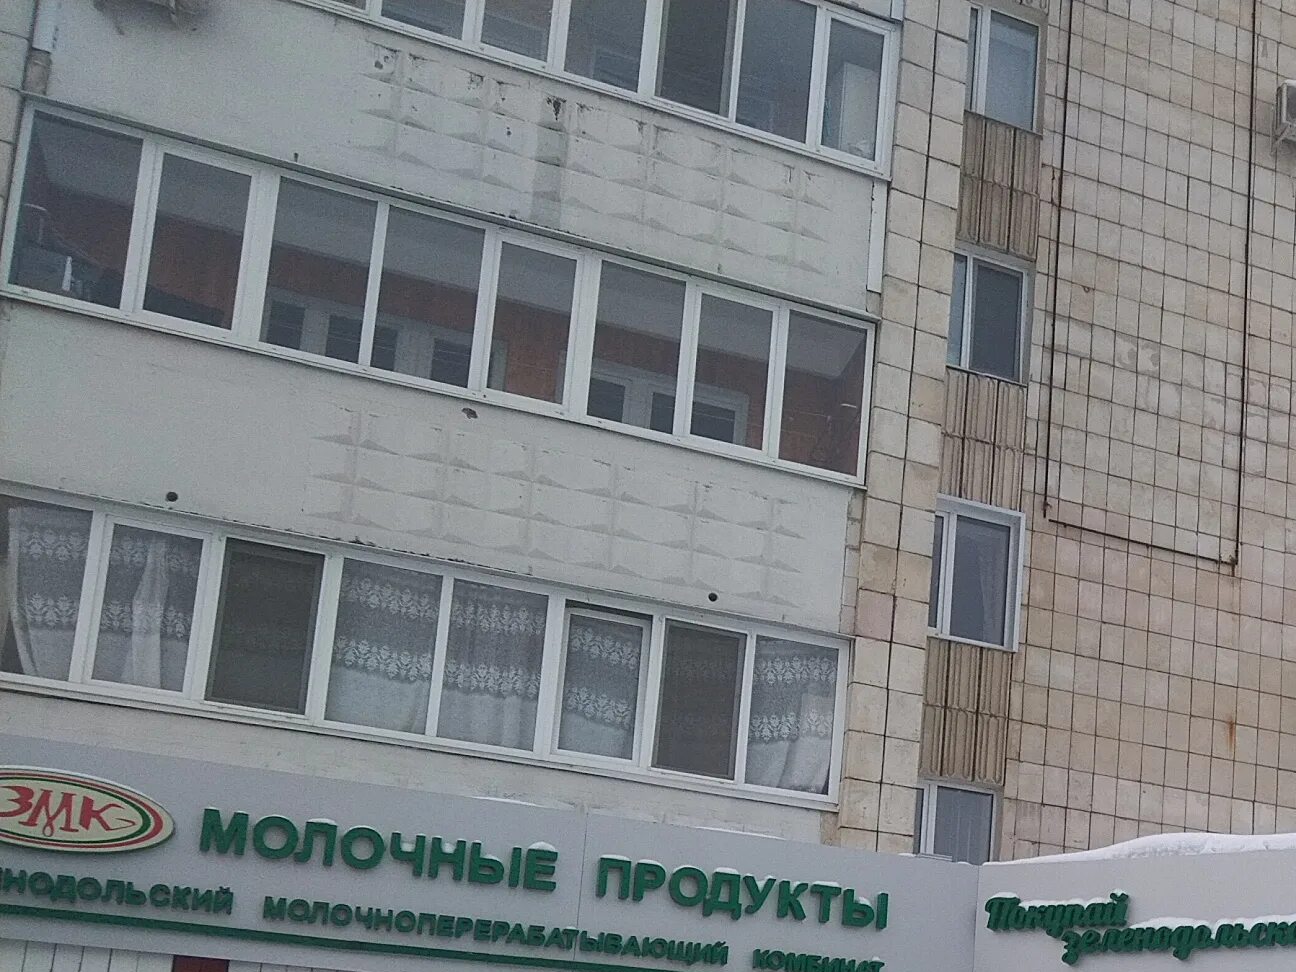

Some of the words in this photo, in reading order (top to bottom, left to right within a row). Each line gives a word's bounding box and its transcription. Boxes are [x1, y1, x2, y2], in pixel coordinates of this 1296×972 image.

[0, 867, 234, 915] НОДОЛЬСКИЙ
[263, 896, 729, 965] МОЛОЧНОПЕРЕРАБАТЫВАЮЩИЙ
[200, 806, 558, 893] МОЛОЧНЫЕ
[596, 855, 889, 930] ПРОДУКТЫ
[985, 892, 1130, 938] Покупай
